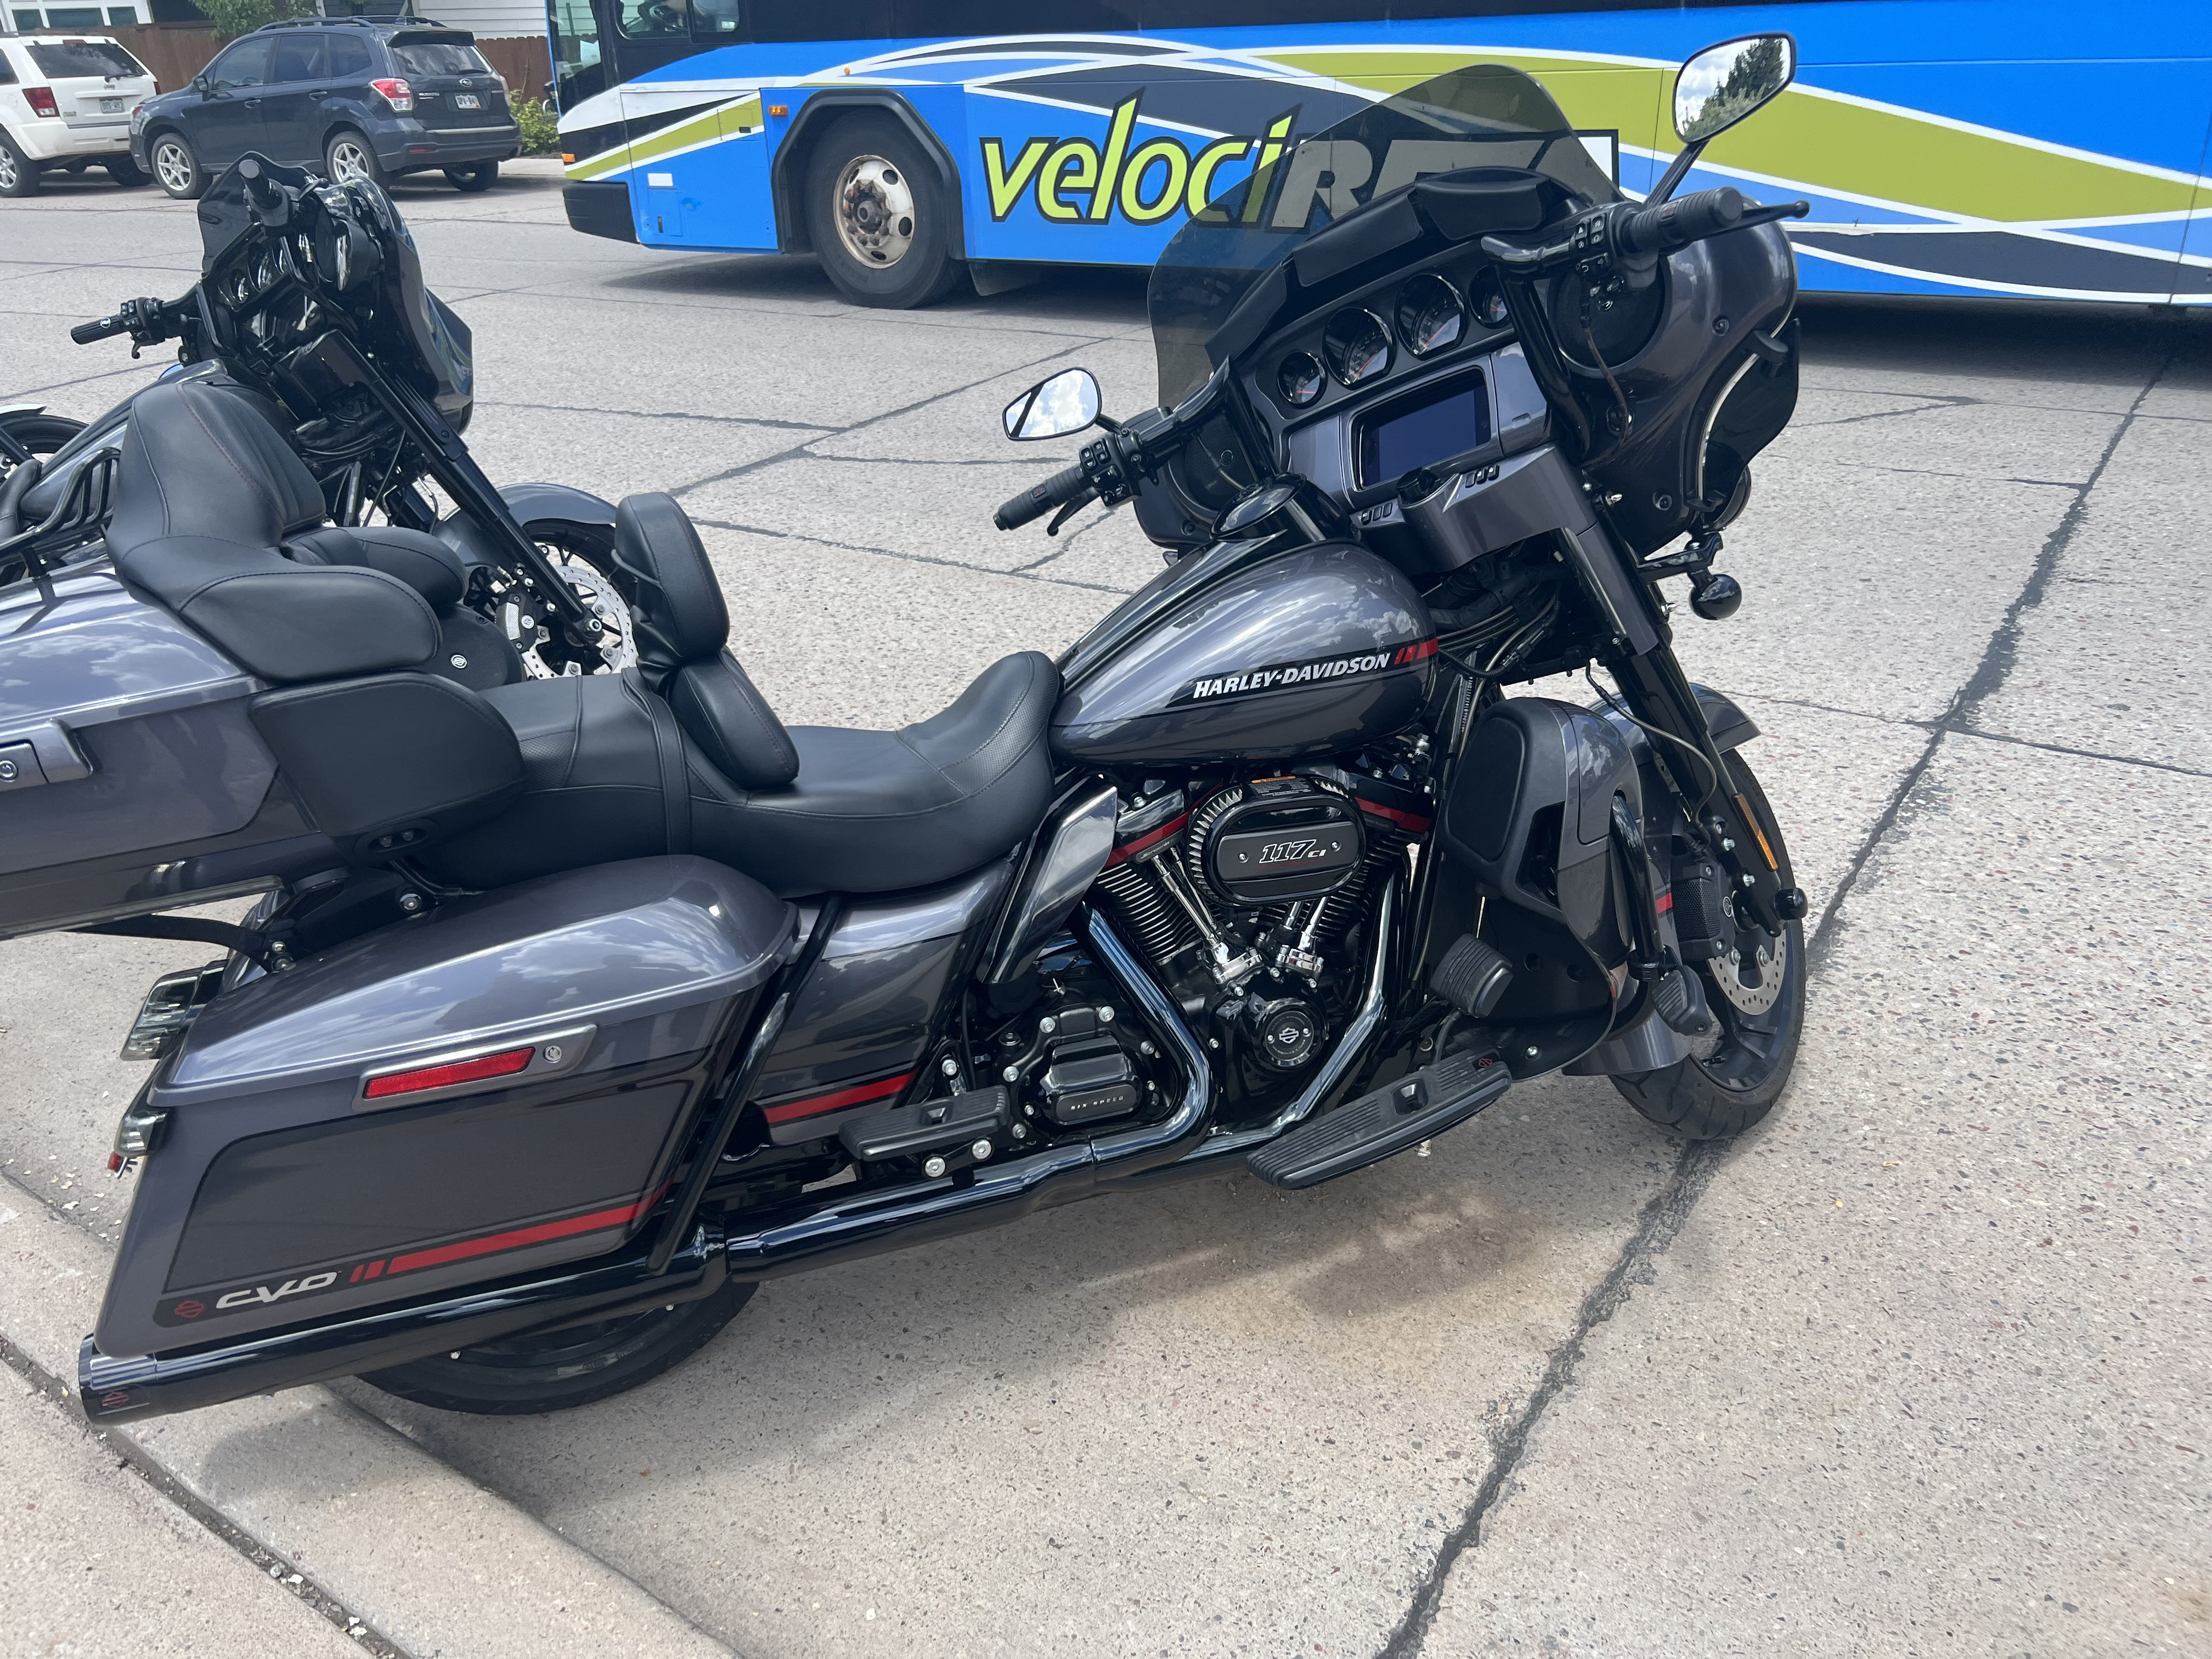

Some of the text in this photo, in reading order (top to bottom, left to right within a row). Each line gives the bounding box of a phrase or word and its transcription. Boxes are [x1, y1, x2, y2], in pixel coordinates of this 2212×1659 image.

[1193, 653, 1391, 699] HARLEY-DAVIDSON
[1259, 839, 1327, 864] 117 CI
[216, 1271, 338, 1309] CVO
